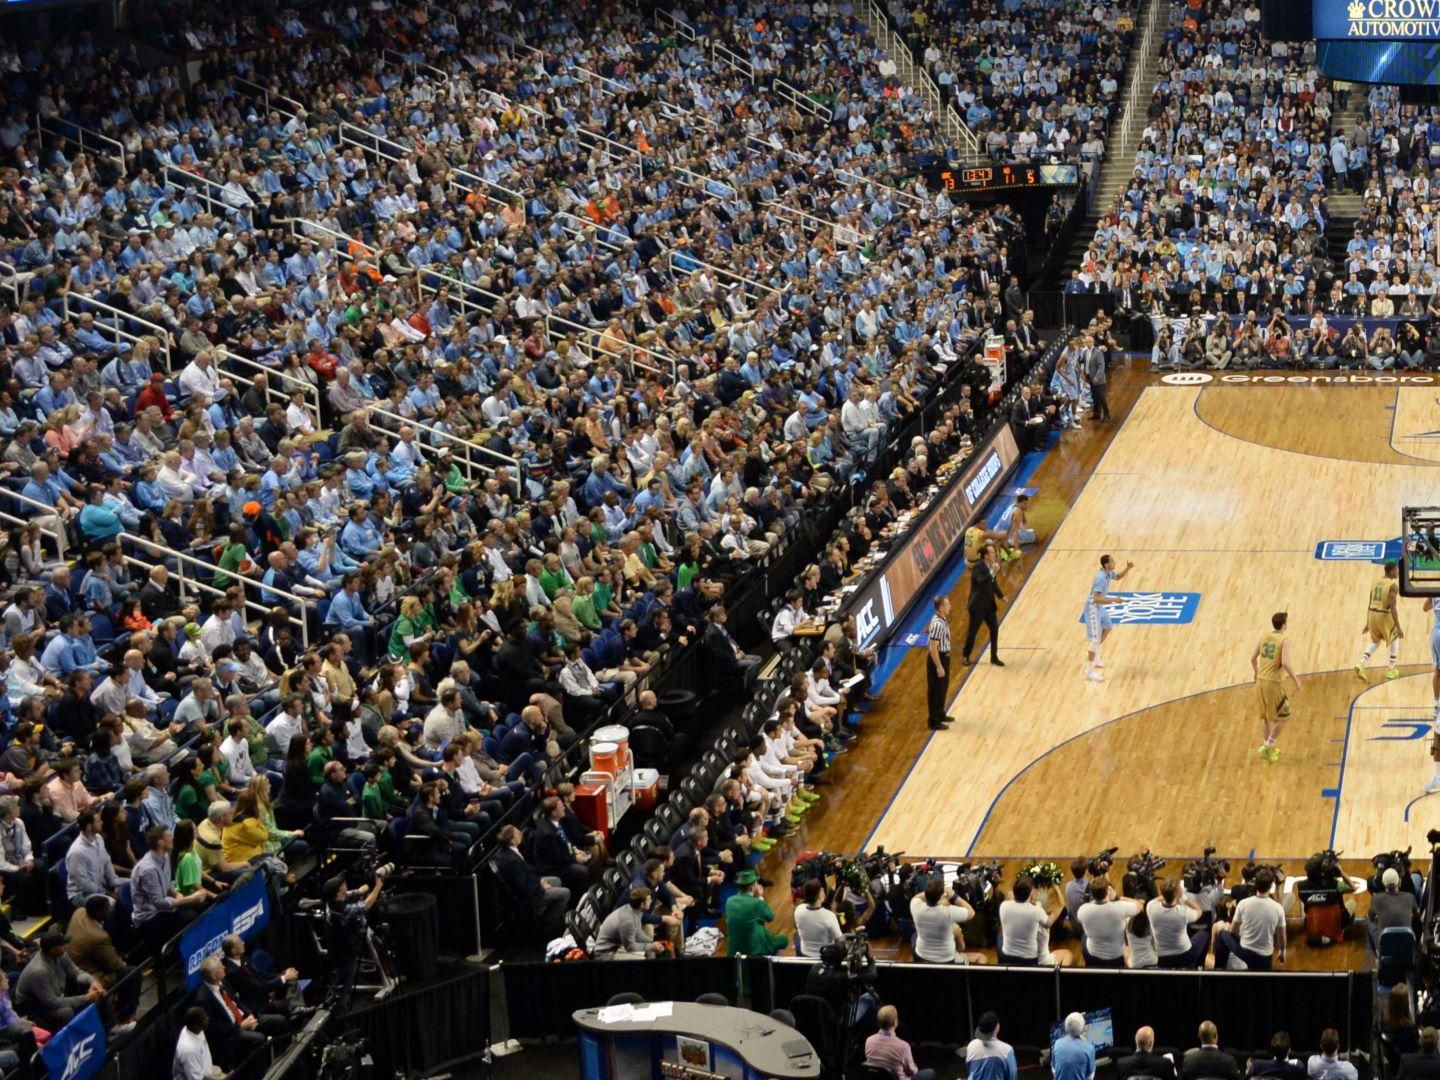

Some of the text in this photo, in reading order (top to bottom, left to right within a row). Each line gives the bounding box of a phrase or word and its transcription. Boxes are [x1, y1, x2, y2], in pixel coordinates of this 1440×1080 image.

[945, 179, 954, 189] 13
[1006, 174, 1015, 184] 11
[1221, 374, 1433, 383] Greensboro
[1120, 593, 1163, 624] YORK
[1150, 596, 1187, 619] LIFE
[855, 598, 880, 642] ACC
[1260, 642, 1276, 660] 32
[61, 1032, 96, 1080] ACC
